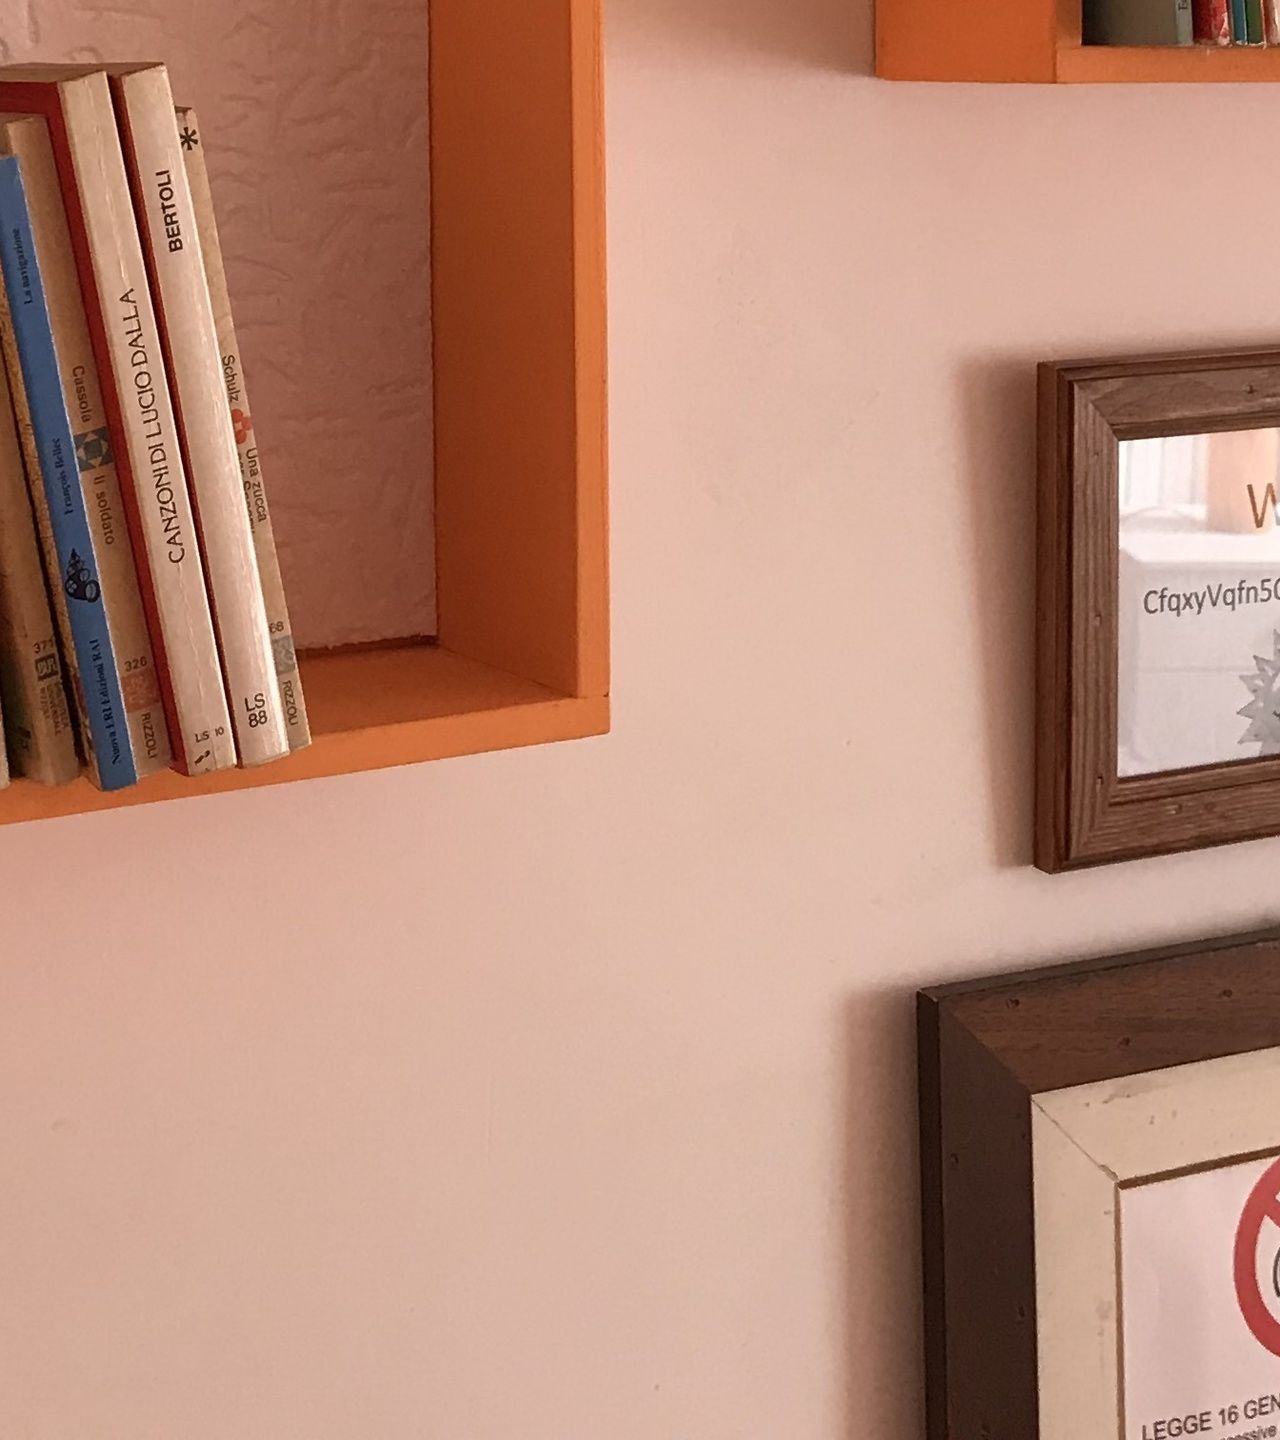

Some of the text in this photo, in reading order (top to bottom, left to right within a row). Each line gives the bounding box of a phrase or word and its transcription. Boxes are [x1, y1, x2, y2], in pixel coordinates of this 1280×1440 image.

[155, 169, 184, 253] BERTOLI
[72, 365, 92, 423] Cassola
[220, 354, 240, 404] Schulz
[119, 287, 185, 565] CANZONI DI LUCIO DALLA
[244, 447, 260, 477] Una
[95, 490, 115, 546] soldato
[250, 478, 268, 523] zucca
[88, 639, 104, 662] RAI
[244, 692, 266, 713] LS
[248, 710, 268, 729] 88
[282, 679, 299, 727] RIZZOLI
[140, 712, 158, 760] RIZZOLI
[194, 730, 211, 743] LS
[1140, 1409, 1214, 1440] LEGGE
[1217, 1404, 1240, 1427] 16
